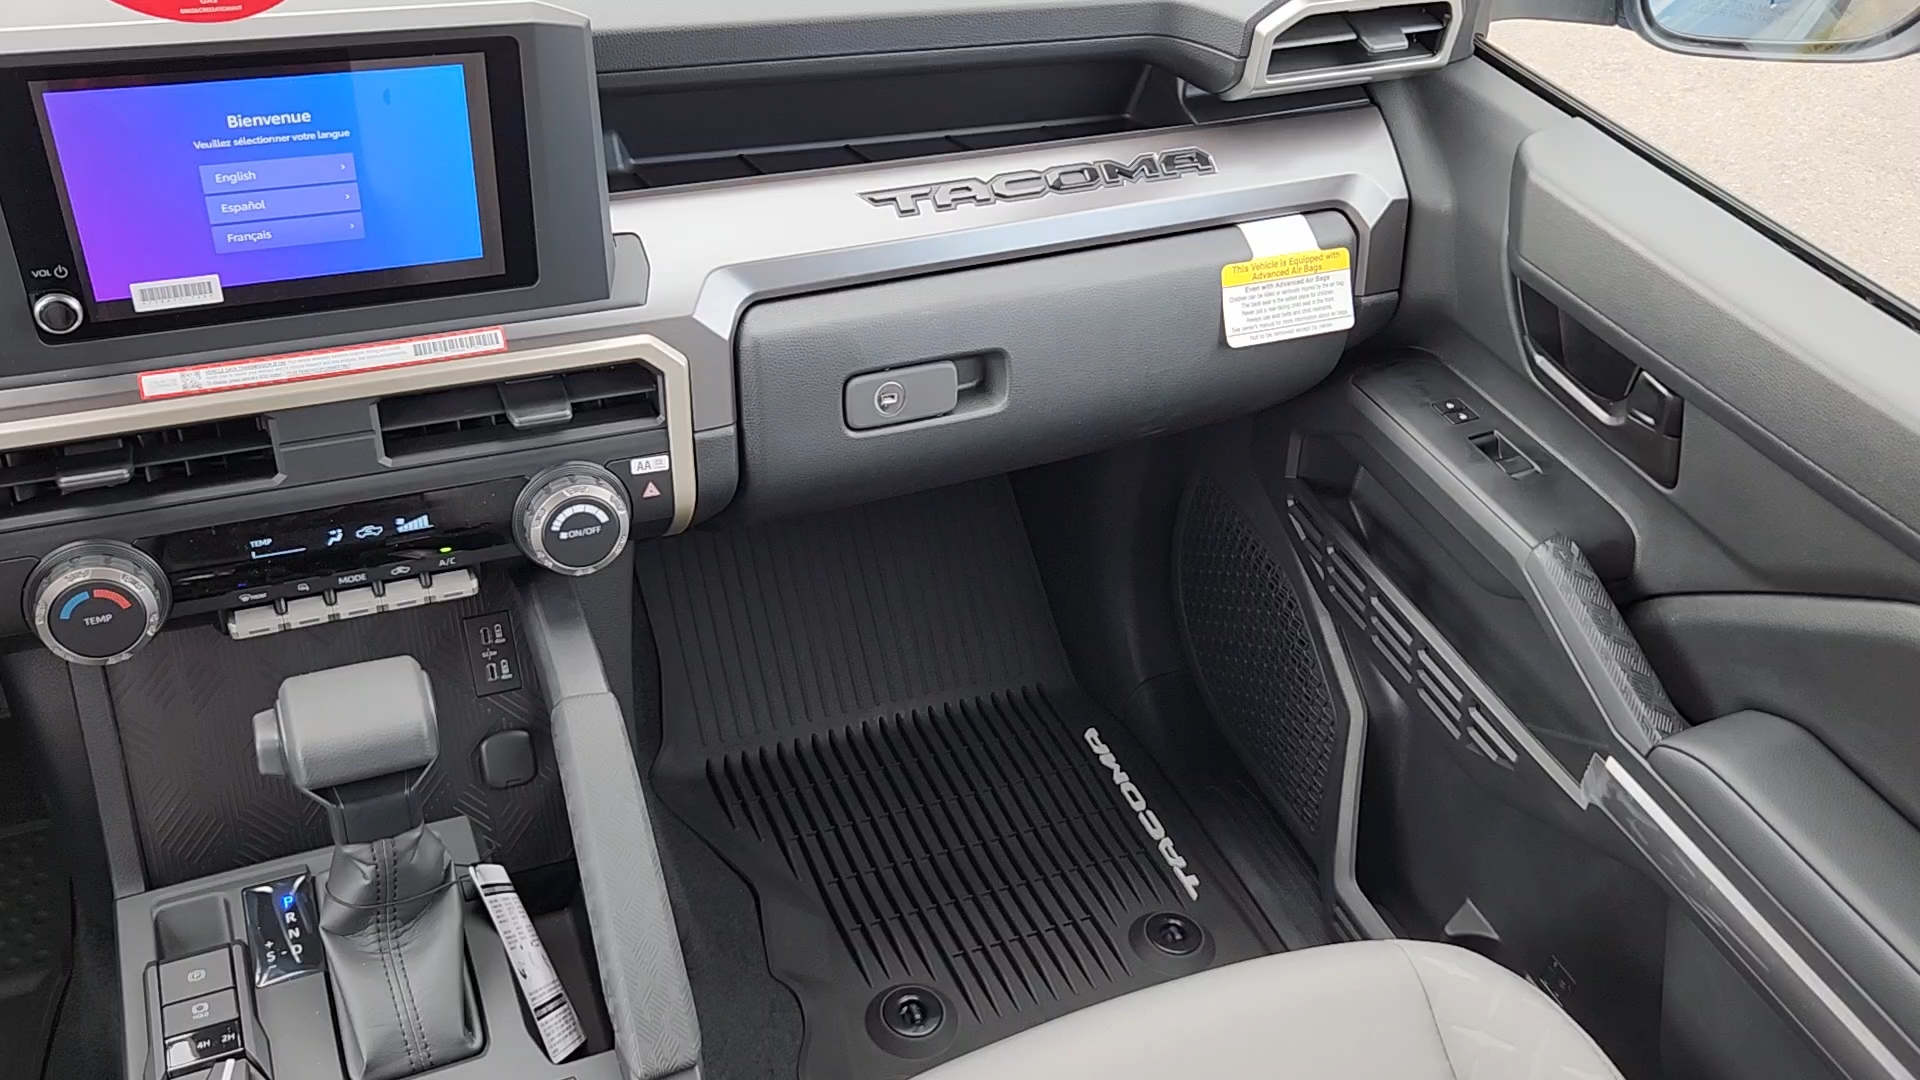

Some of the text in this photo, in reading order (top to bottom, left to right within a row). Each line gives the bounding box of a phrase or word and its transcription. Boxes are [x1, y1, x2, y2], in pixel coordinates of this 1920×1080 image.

[227, 112, 311, 128] Bienvenue
[193, 130, 350, 150] Veuillez sélectionner votre langue
[215, 171, 256, 185] English
[856, 146, 1219, 218] TACOMA
[221, 200, 266, 214] Español
[227, 230, 272, 243] Français
[1232, 264, 1248, 274] This
[1251, 260, 1278, 271] Vehicle
[1289, 253, 1323, 266] Equipped
[1325, 251, 1340, 259] with
[31, 269, 52, 278] VOL
[1251, 263, 1322, 280] Advanced Air Bags
[1244, 285, 1260, 293] Even
[1261, 282, 1274, 290] with
[1275, 278, 1304, 288] Advanced
[1315, 274, 1329, 282] Bags
[636, 460, 651, 472] AA
[568, 526, 602, 538] ON/OFF
[249, 538, 273, 549] TEMP
[438, 557, 457, 567] A/C
[338, 573, 368, 585] MODE
[83, 613, 113, 627] TEMP
[1084, 727, 1200, 901] TACOMA
[283, 896, 294, 909] P
[285, 912, 297, 924] R
[288, 927, 300, 940] N
[266, 951, 276, 963] S
[196, 1033, 236, 1050] 4H 2H
